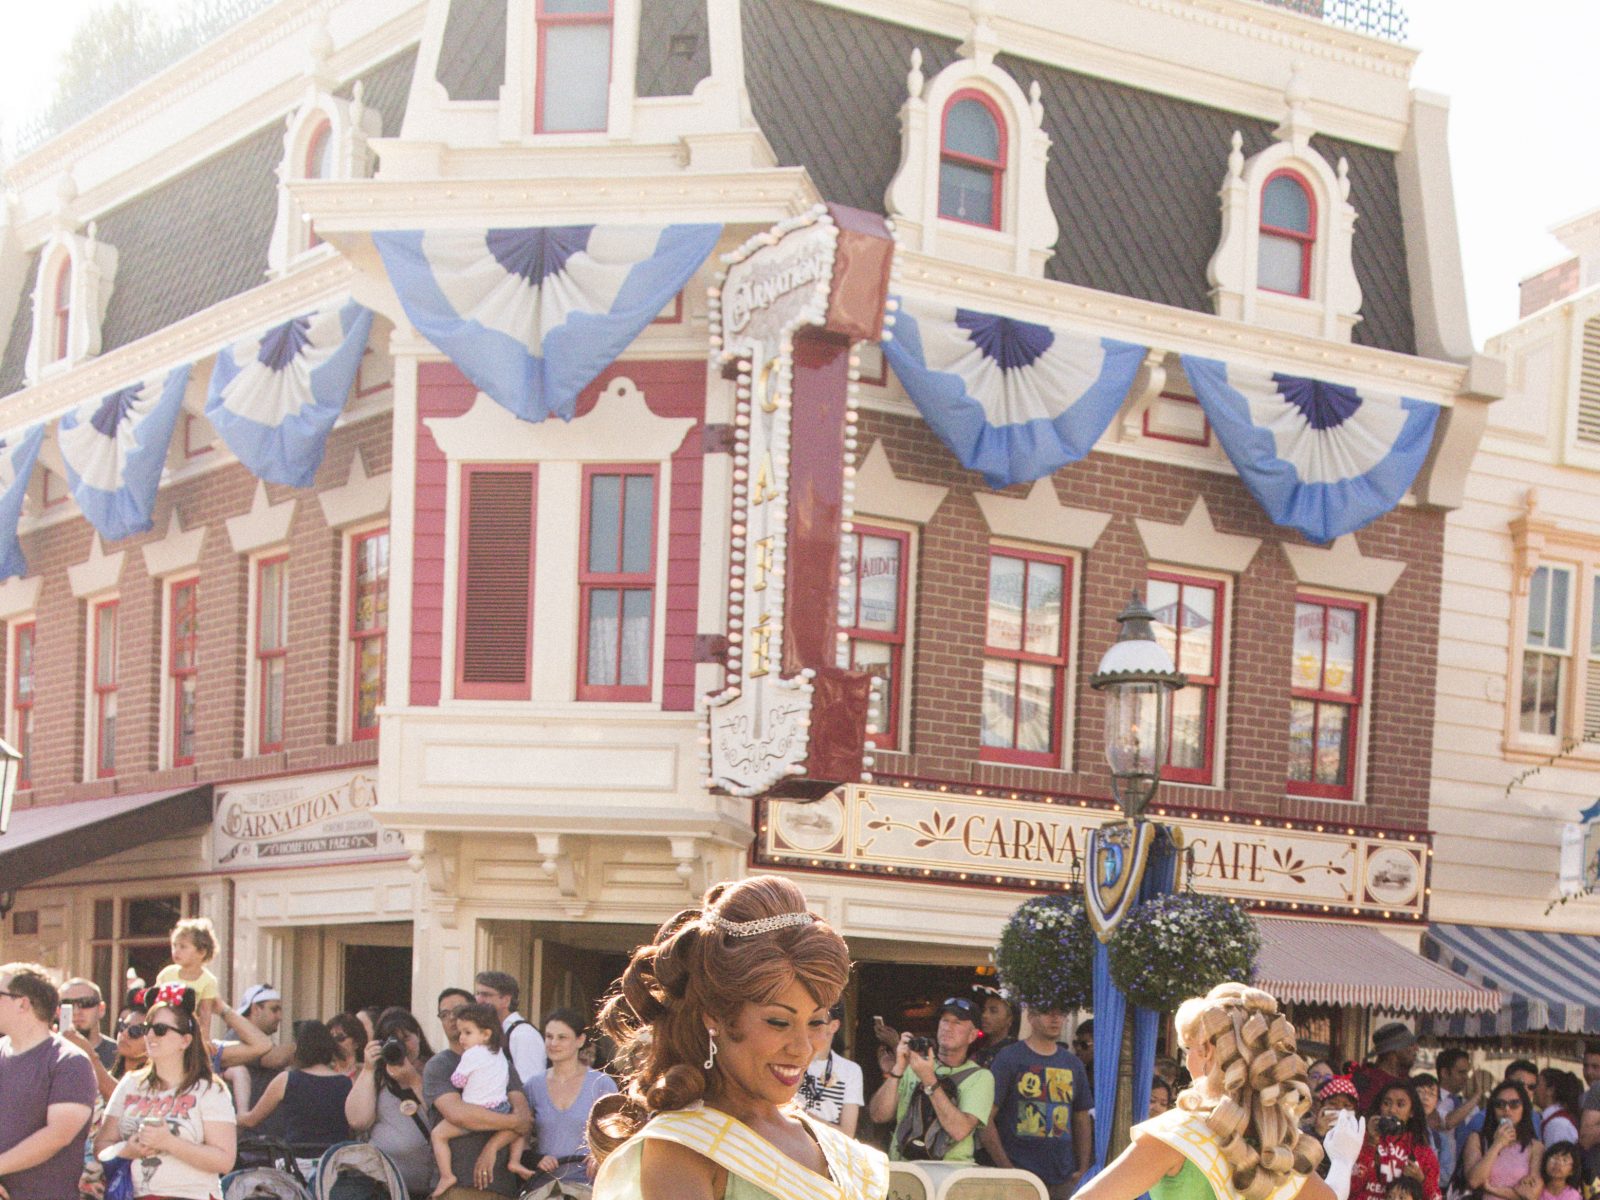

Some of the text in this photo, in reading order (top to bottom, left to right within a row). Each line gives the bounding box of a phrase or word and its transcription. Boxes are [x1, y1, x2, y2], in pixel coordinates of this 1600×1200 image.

[222, 773, 378, 838] CARNATION CA
[963, 815, 1099, 864] CARNA
[124, 1094, 198, 1120] THOR
